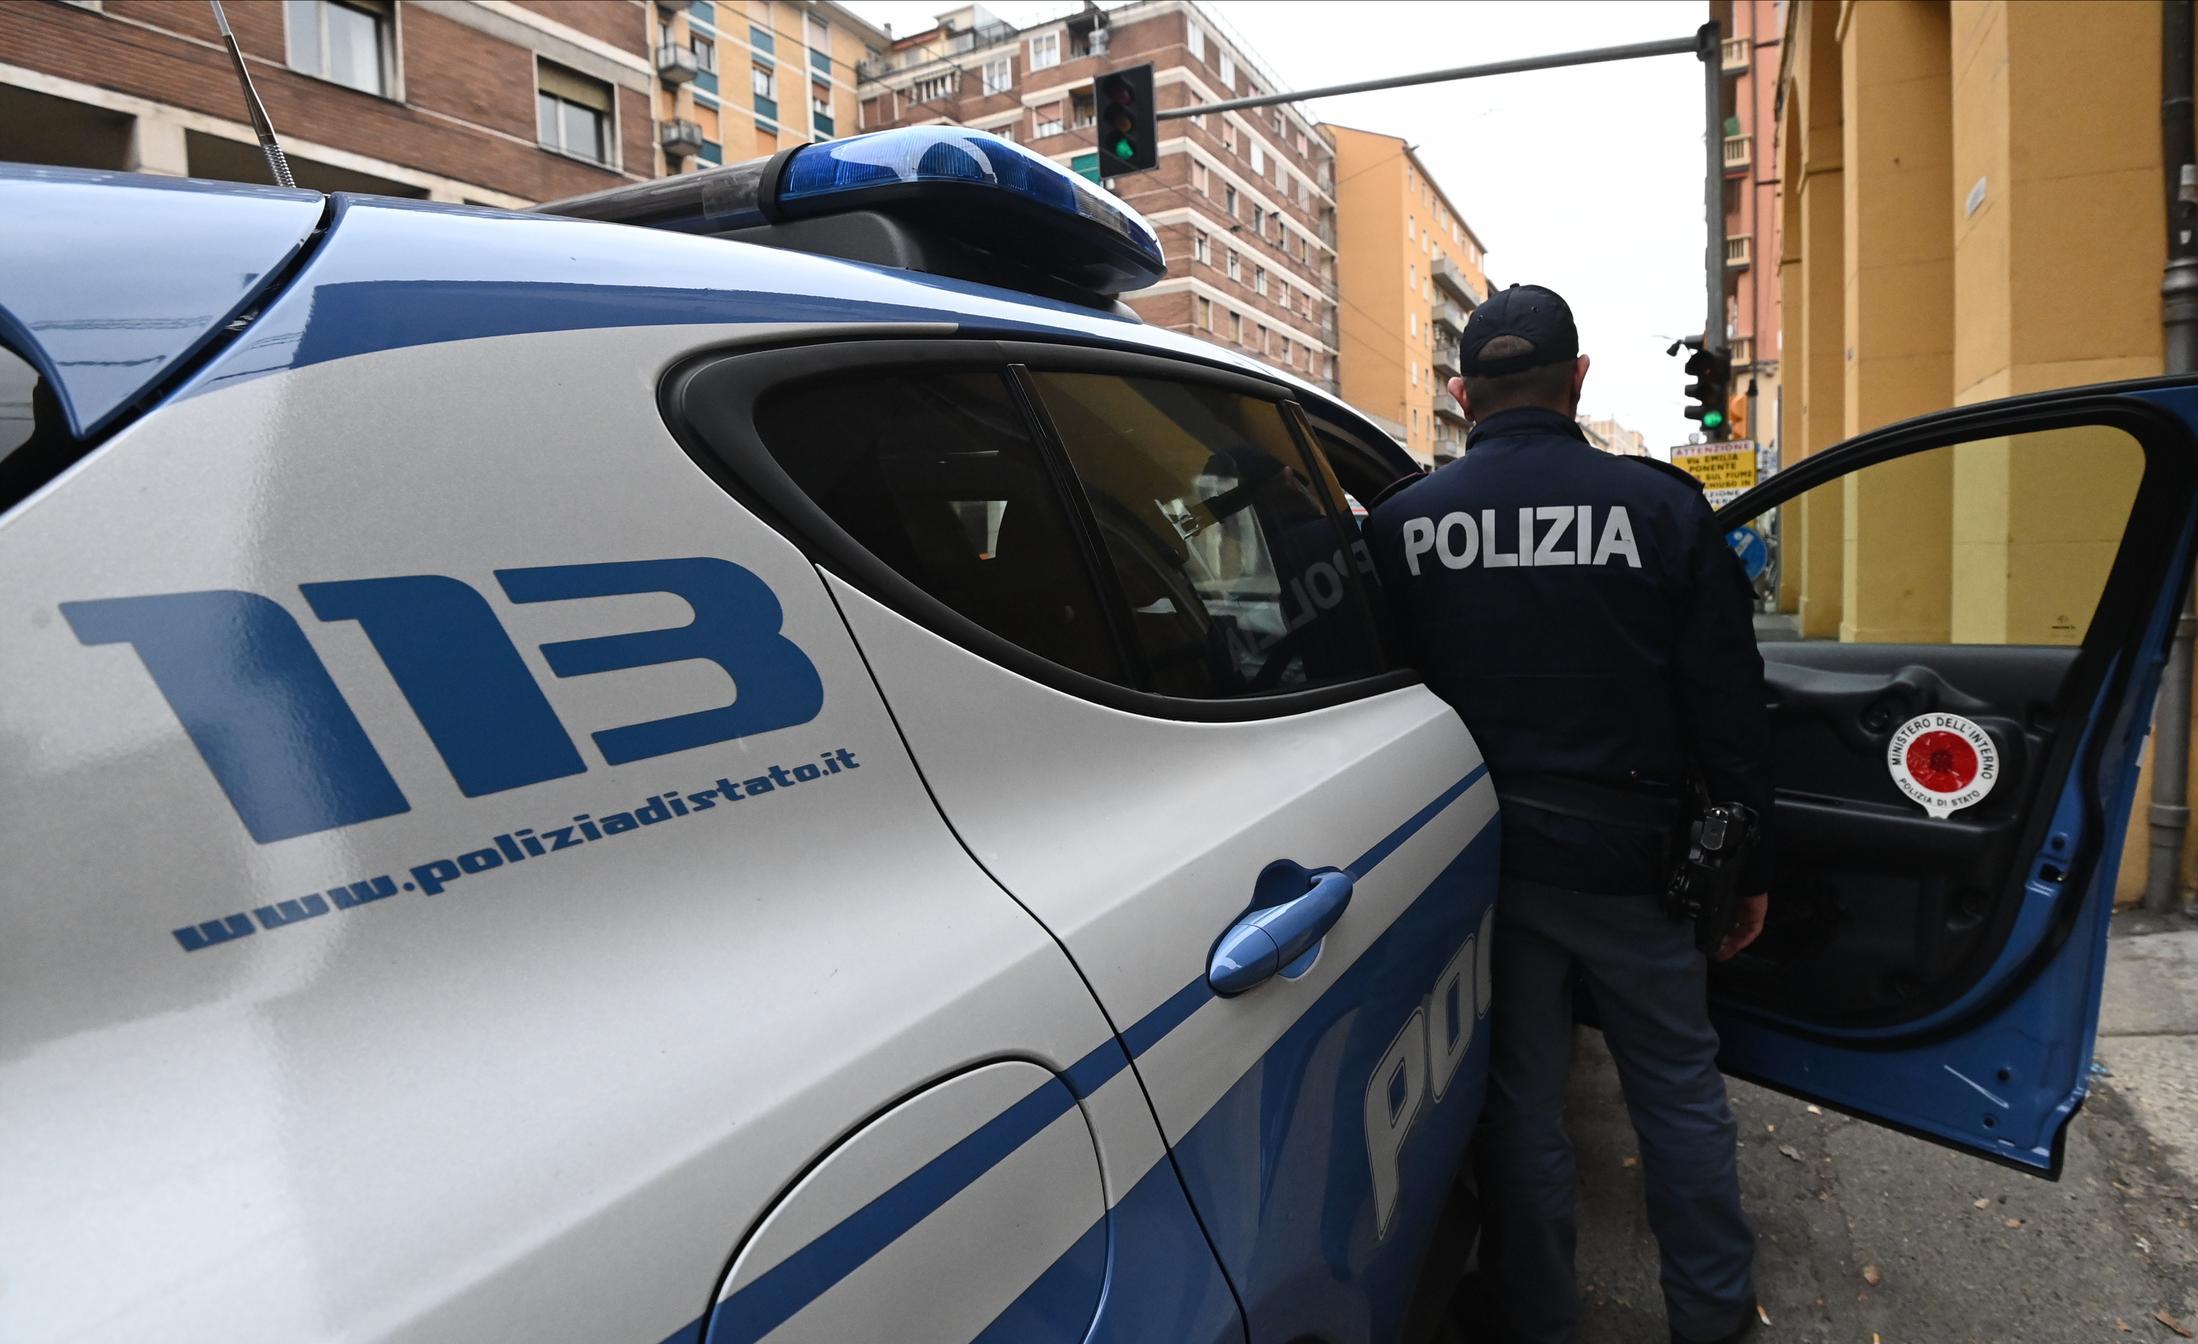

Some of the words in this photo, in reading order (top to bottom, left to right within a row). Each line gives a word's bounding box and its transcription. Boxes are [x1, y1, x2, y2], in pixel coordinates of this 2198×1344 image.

[1676, 443, 1749, 455] ATTENZIONE
[1704, 453, 1739, 463] EMILIA
[1689, 463, 1736, 472] PONENTE
[1726, 471, 1752, 479] FIUME
[1403, 505, 1642, 576] POLIZIA
[58, 556, 824, 845] 113
[1892, 718, 1931, 766] MINISTERO
[1936, 717, 1994, 780] DELL'INTERNO
[1900, 778, 1933, 804] POLIZIA
[1937, 799, 1947, 807] DI
[1951, 790, 1980, 806] STATO
[172, 747, 861, 952] www.poliziadistato.it
